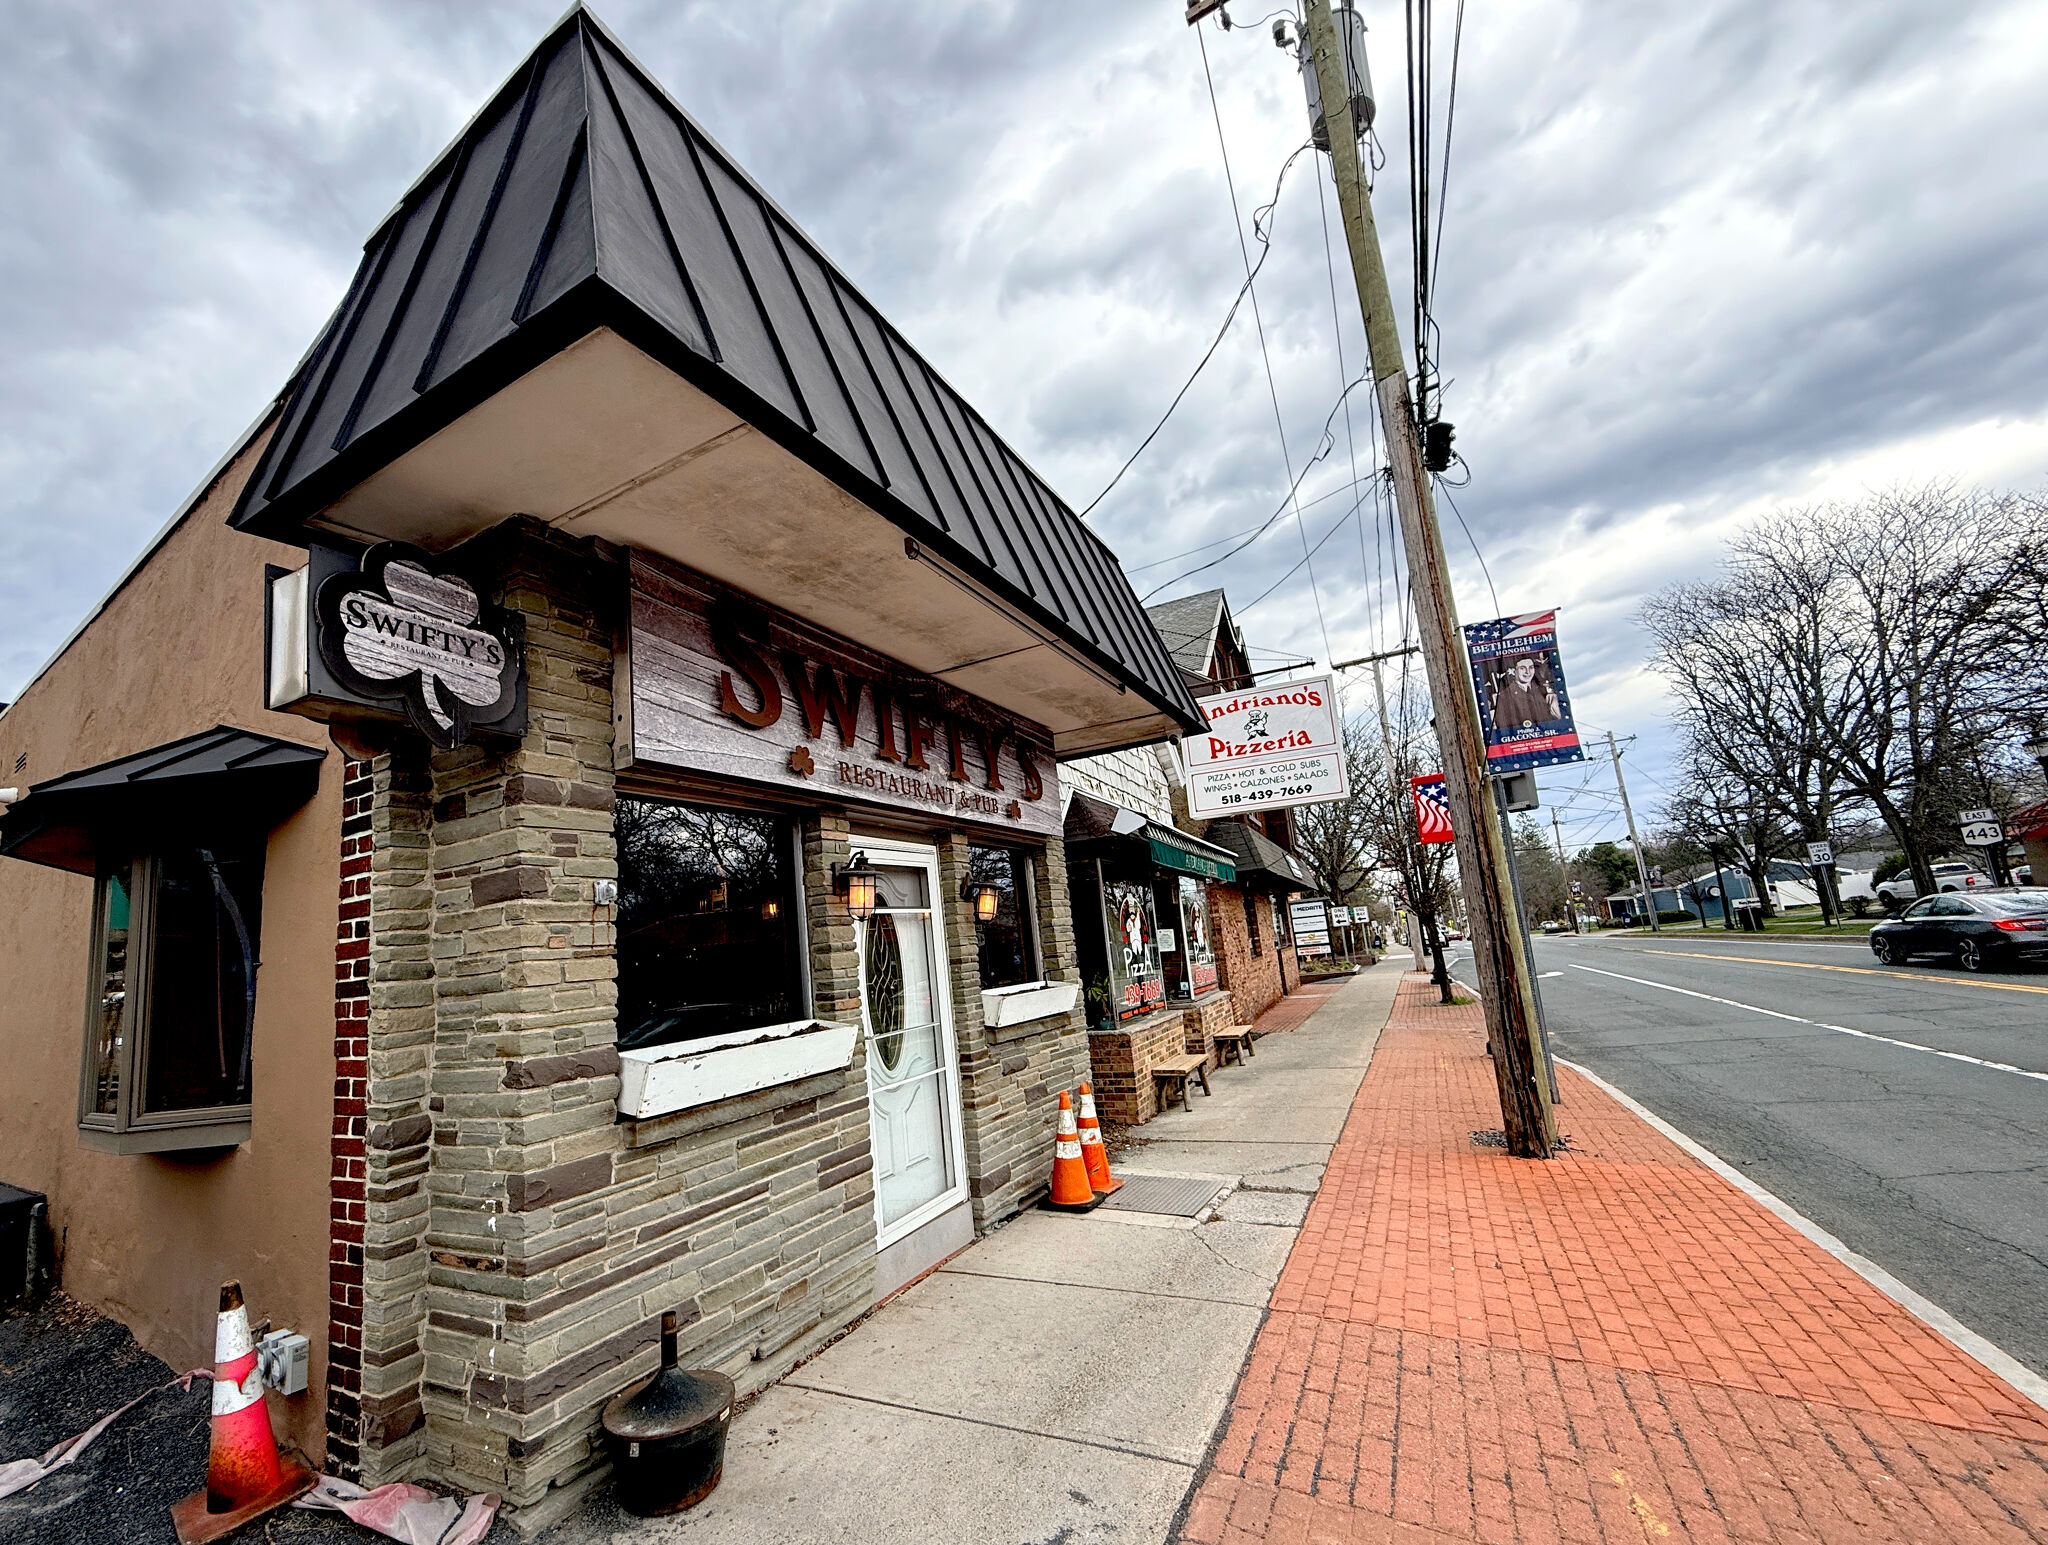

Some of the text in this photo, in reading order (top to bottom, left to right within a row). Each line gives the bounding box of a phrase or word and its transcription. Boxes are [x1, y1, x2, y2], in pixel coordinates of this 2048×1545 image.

[346, 599, 501, 665] SWIFTY'S
[1471, 632, 1553, 655] BETHLEHEM
[390, 641, 443, 661] RESTAURANT
[451, 657, 466, 666] PUB
[1495, 645, 1531, 657] HONORS
[711, 600, 1044, 802] SWIFTY'S
[1544, 728, 1560, 737] SR.
[1207, 729, 1313, 760] Pizzeria
[1203, 768, 1329, 793] WINGS CALZONES SALADS
[1207, 759, 1322, 783] PIZZA HOT & COLD SUBS
[838, 760, 999, 814] RESTAURANT & PUB
[1221, 783, 1313, 805] 518-439-7669
[1964, 811, 1987, 821] EAST
[1965, 826, 2000, 841] 443
[1813, 852, 1831, 863] 30
[1296, 904, 1323, 912] MEDRITE
[1124, 978, 1161, 1007] 439-7669
